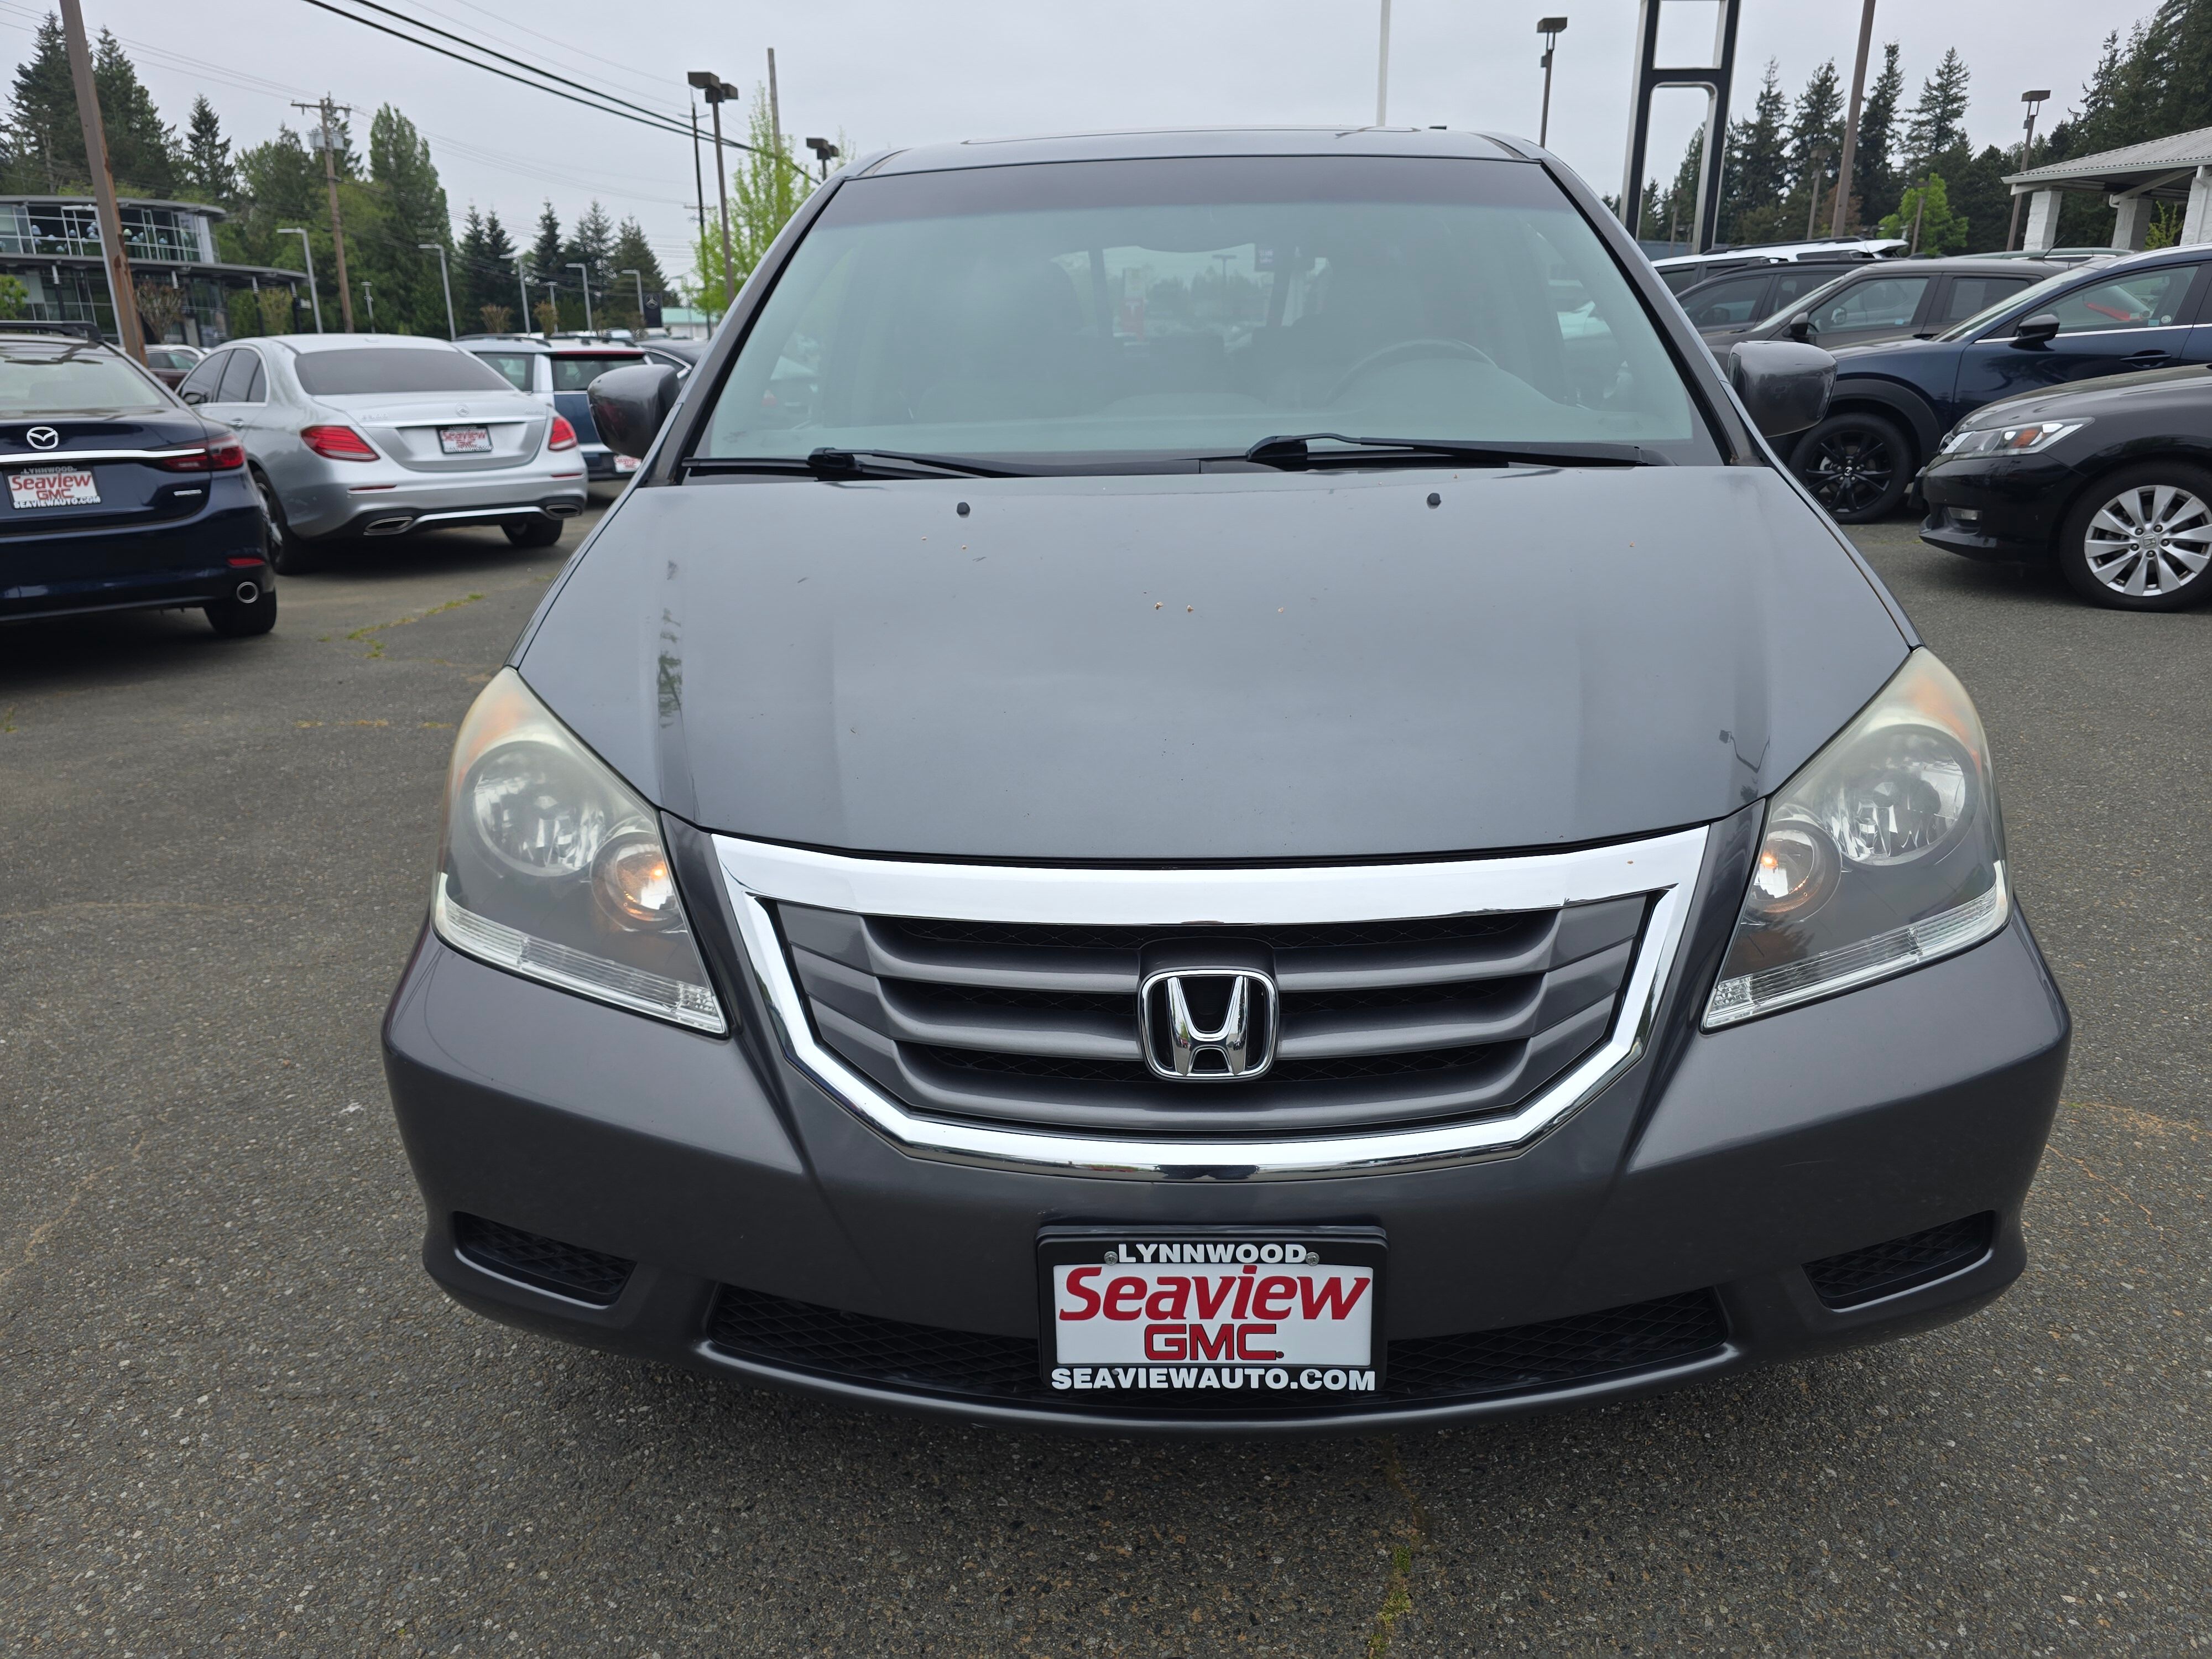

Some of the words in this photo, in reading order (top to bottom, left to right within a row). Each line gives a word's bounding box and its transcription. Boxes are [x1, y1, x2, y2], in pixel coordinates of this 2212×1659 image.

[12, 473, 92, 492] Seaview
[13, 495, 101, 509] SEAVIEWAUTO.COM
[36, 489, 75, 500] GMC
[1118, 1243, 1307, 1264] LYNNWOOD
[1058, 1264, 1371, 1321] Seaview
[1051, 1367, 1376, 1391] SEAVIEWAUTO.COM
